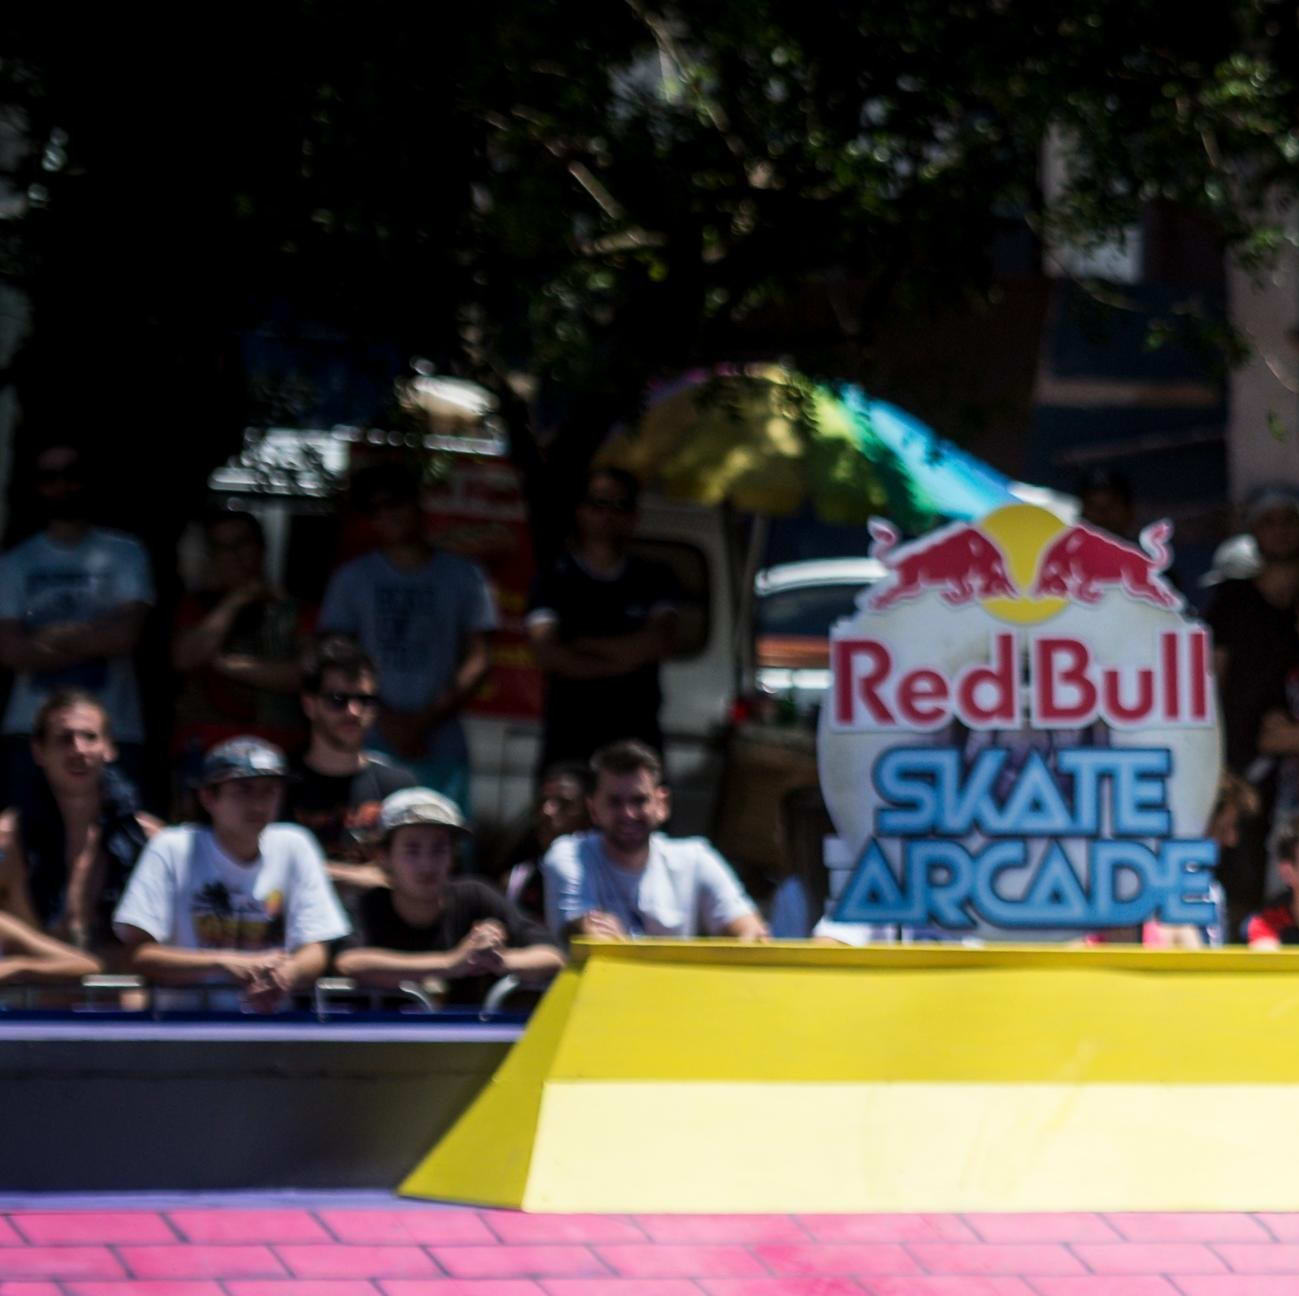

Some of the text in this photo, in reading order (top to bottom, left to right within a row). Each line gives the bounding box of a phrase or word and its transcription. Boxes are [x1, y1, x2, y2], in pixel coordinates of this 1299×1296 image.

[834, 631, 1209, 725] Red Bull
[873, 746, 1172, 837] SKATE
[830, 837, 1219, 928] ARCADE
